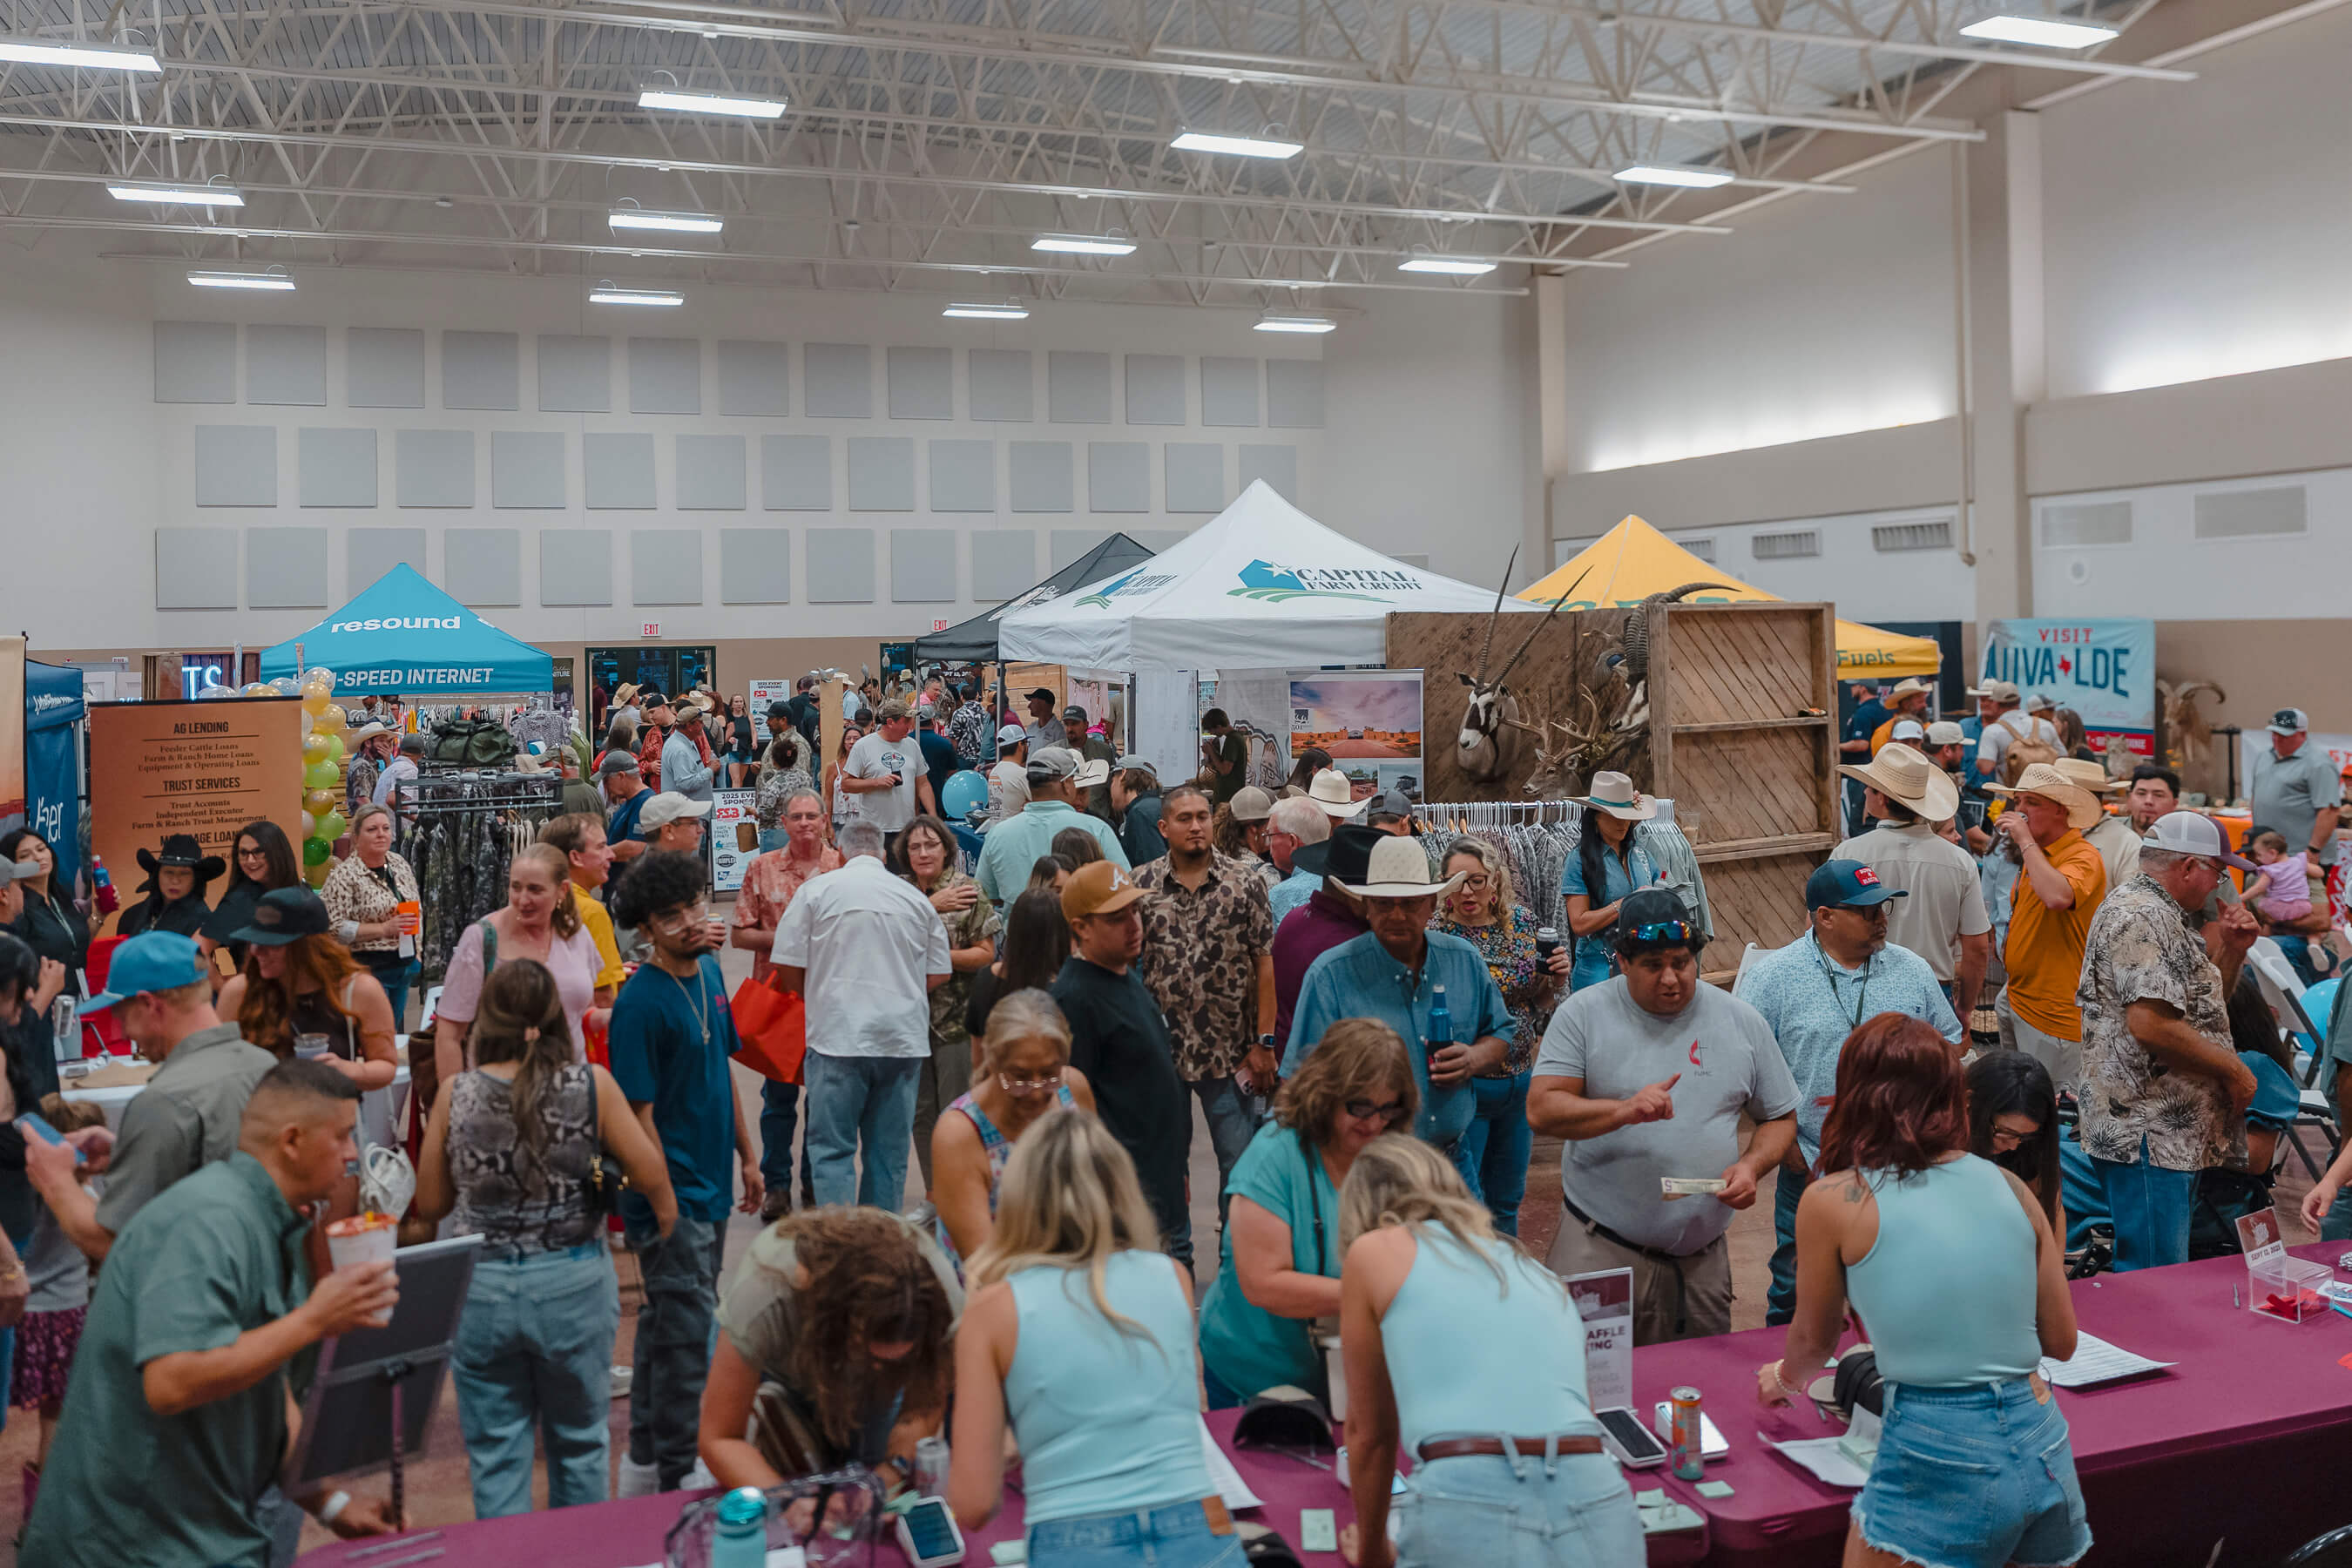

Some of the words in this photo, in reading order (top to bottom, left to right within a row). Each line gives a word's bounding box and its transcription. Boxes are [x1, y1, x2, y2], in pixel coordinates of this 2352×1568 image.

[1297, 568, 1417, 582] CAPITAL
[1307, 582, 1355, 591] FARM
[1362, 582, 1422, 591] CREDIT
[331, 616, 461, 633] resound
[644, 624, 659, 635] EXIT
[934, 620, 947, 631] EXIT
[2038, 628, 2093, 644] VISIT
[1837, 648, 1896, 667] Fuels
[293, 669, 403, 687] -SPEED
[407, 667, 494, 685] INTERNET
[173, 722, 186, 734] AG
[188, 721, 229, 733] LENDING
[189, 743, 213, 752] Cattle
[138, 763, 183, 774] Equipment
[193, 760, 235, 770] Operating
[163, 780, 193, 792] TRUST
[195, 777, 241, 790] SERVICES
[155, 808, 207, 820] Independent
[209, 807, 244, 815] Executor
[166, 818, 191, 828] Ranch
[215, 814, 267, 825] Management
[159, 831, 213, 847] MAGE
[213, 829, 239, 842] LOAN
[1586, 1325, 1625, 1340] AFFLE
